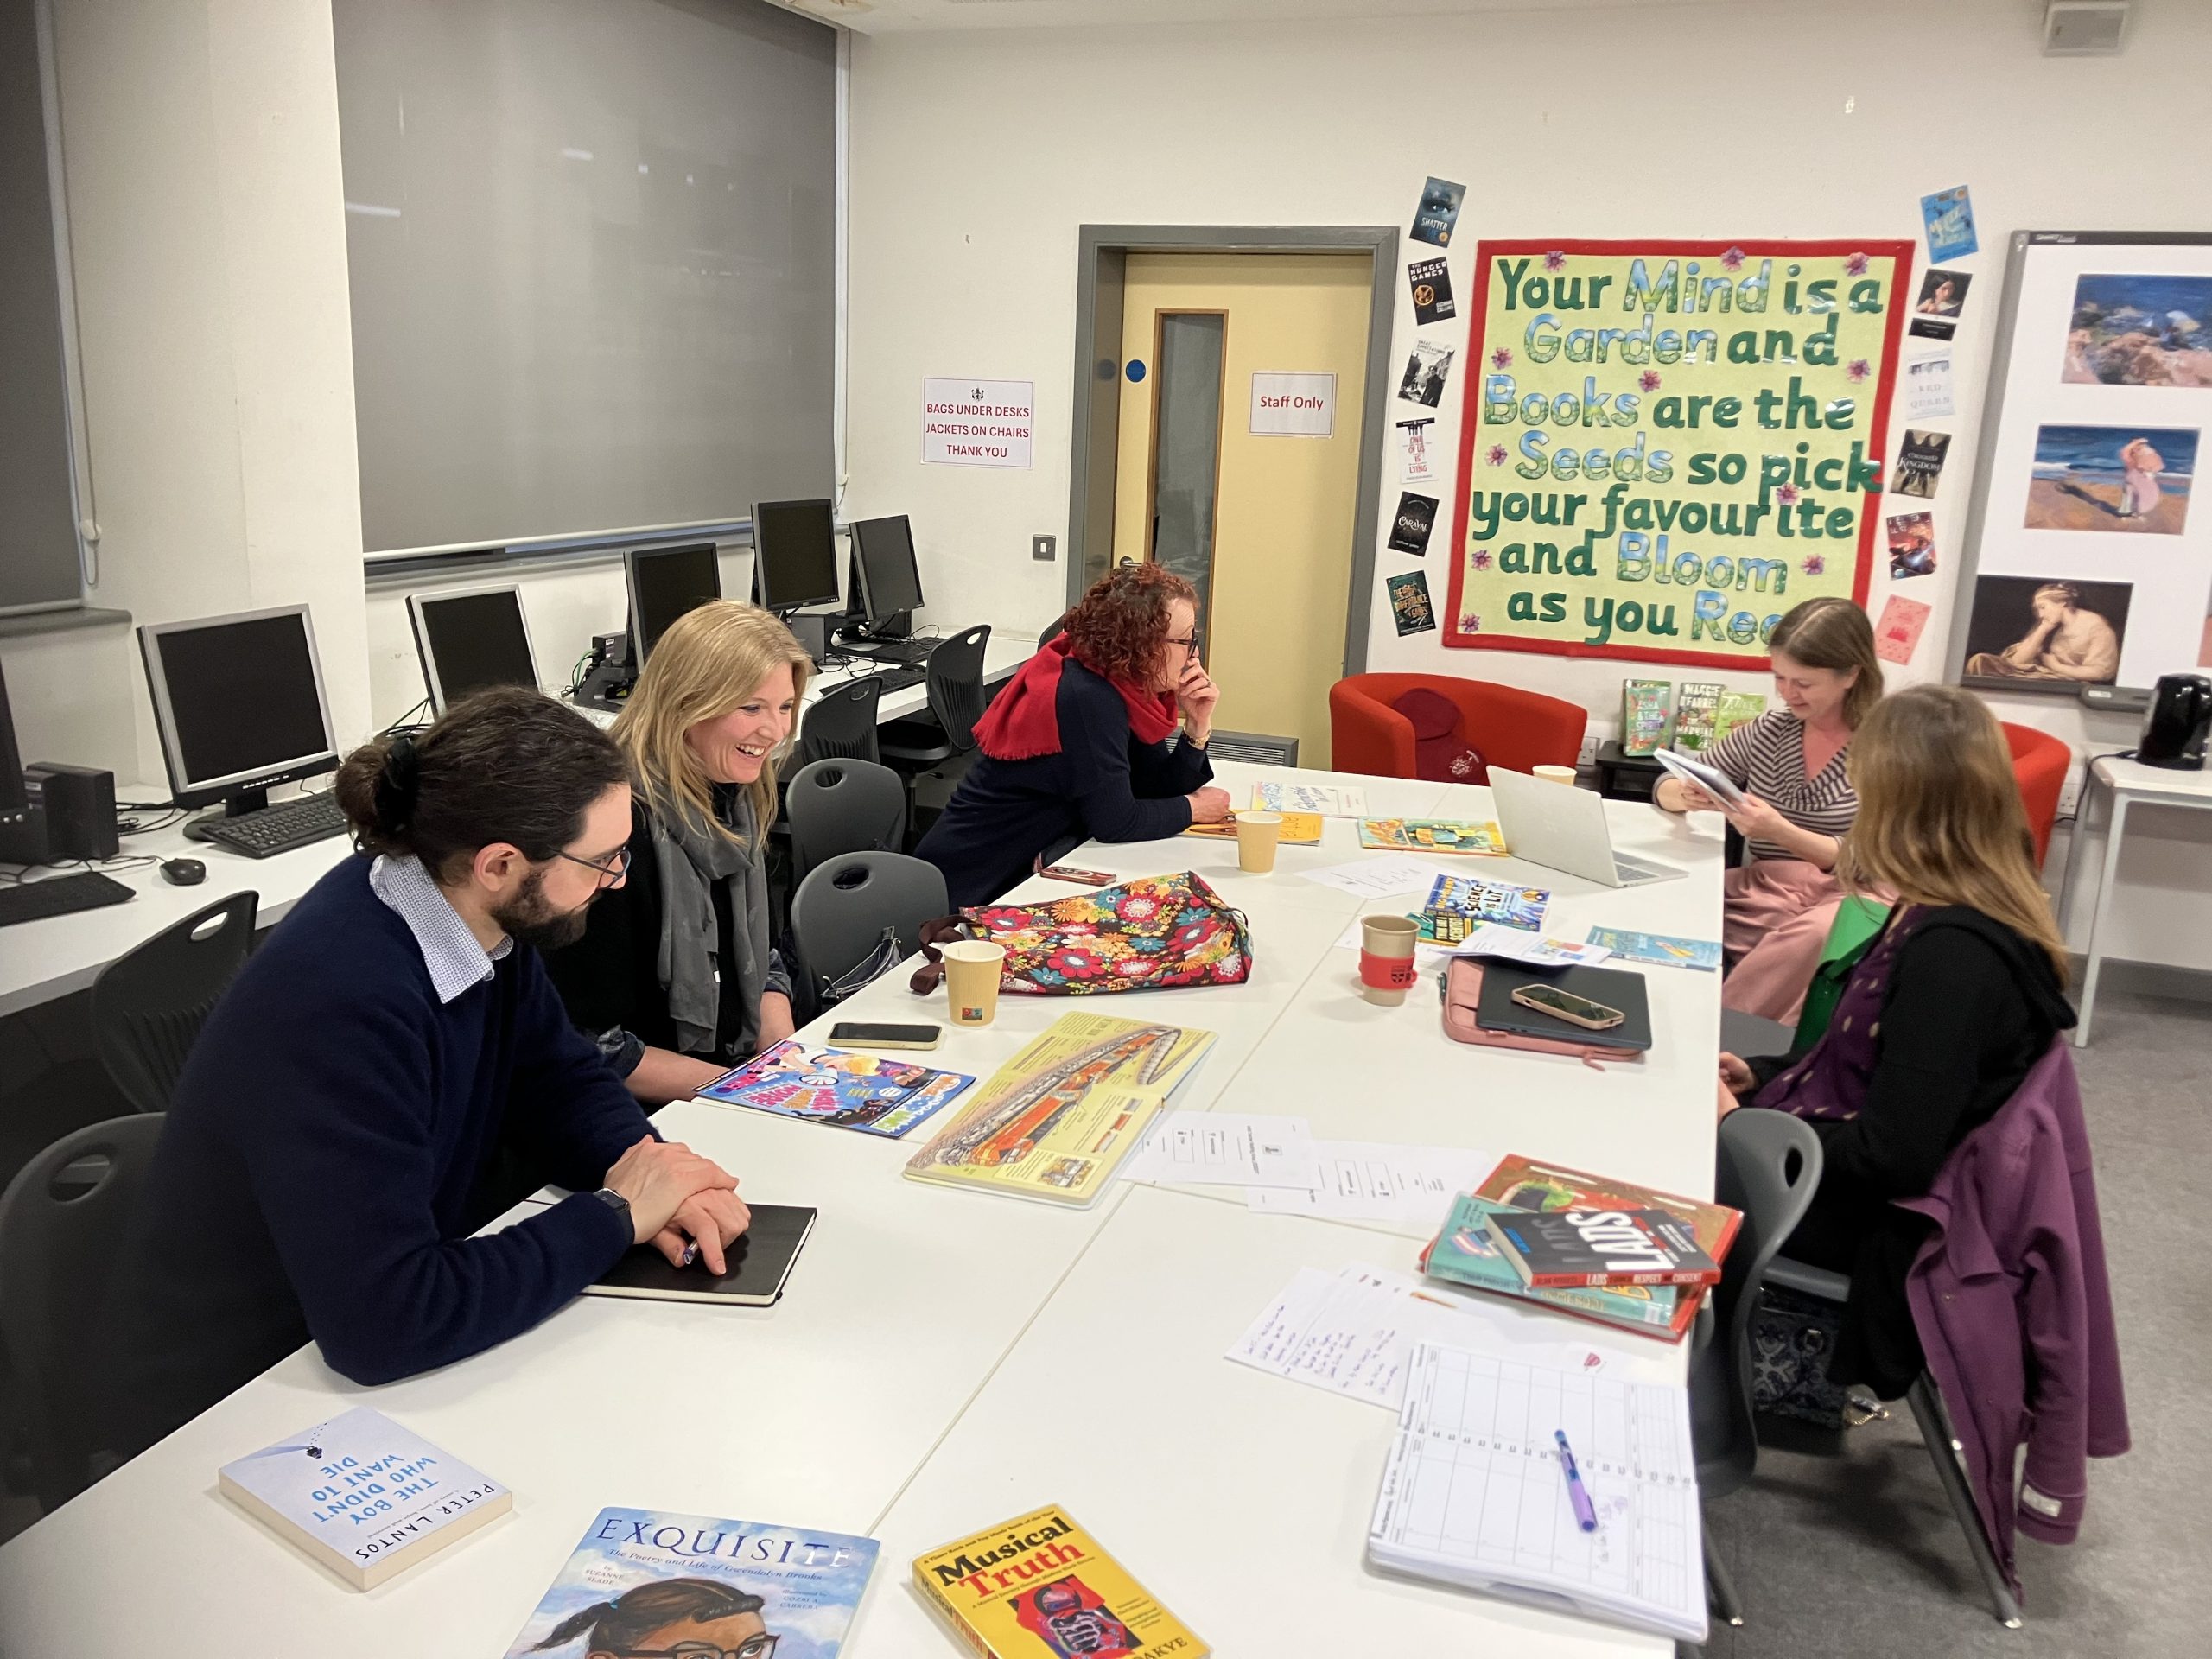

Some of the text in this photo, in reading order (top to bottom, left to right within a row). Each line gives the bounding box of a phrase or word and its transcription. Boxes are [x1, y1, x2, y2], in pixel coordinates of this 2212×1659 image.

[1421, 217, 1448, 231] SHATTER
[1410, 261, 1446, 275] HUNGER
[1411, 269, 1443, 281] GAMES
[1497, 259, 1884, 315] Your Mind is a
[1523, 313, 1840, 366] Garden and
[926, 403, 1029, 417] BAGS UNDER DESKS
[1261, 396, 1324, 410] Staff Only
[1484, 374, 1856, 430] Books are the
[925, 423, 1029, 438] JACKETS ON CHAIRS
[946, 444, 1007, 457] THANK YOU
[1514, 430, 1884, 508] Seeds so pick
[1398, 516, 1427, 532] CARAVAL
[1472, 488, 1587, 539] your
[1590, 483, 1854, 539] favourite
[1498, 529, 1788, 595] and Bloom
[1507, 590, 1783, 645] as you Re
[1465, 883, 1487, 912] SCIENCE
[1565, 1211, 1675, 1270] LADS
[311, 1454, 405, 1502] WANT TO
[312, 1457, 437, 1523] WHO DIDN'T
[320, 1456, 359, 1478] DIE
[348, 1477, 440, 1526] THE BOY
[355, 1484, 495, 1560] PETER LANTOS
[596, 1518, 855, 1568] EXQUISITE
[607, 1548, 628, 1558] The
[629, 1552, 664, 1563] Poetry
[666, 1558, 686, 1567] and
[688, 1560, 709, 1569] Life
[724, 1565, 784, 1578] Gwendolyn
[785, 1571, 823, 1580] Brooks
[931, 1516, 1074, 1587] Musical
[585, 1570, 625, 1580] SUZANNE
[587, 1577, 615, 1586] SLADE
[958, 1542, 1085, 1599] Truth
[1133, 1637, 1188, 1659] AKYE
